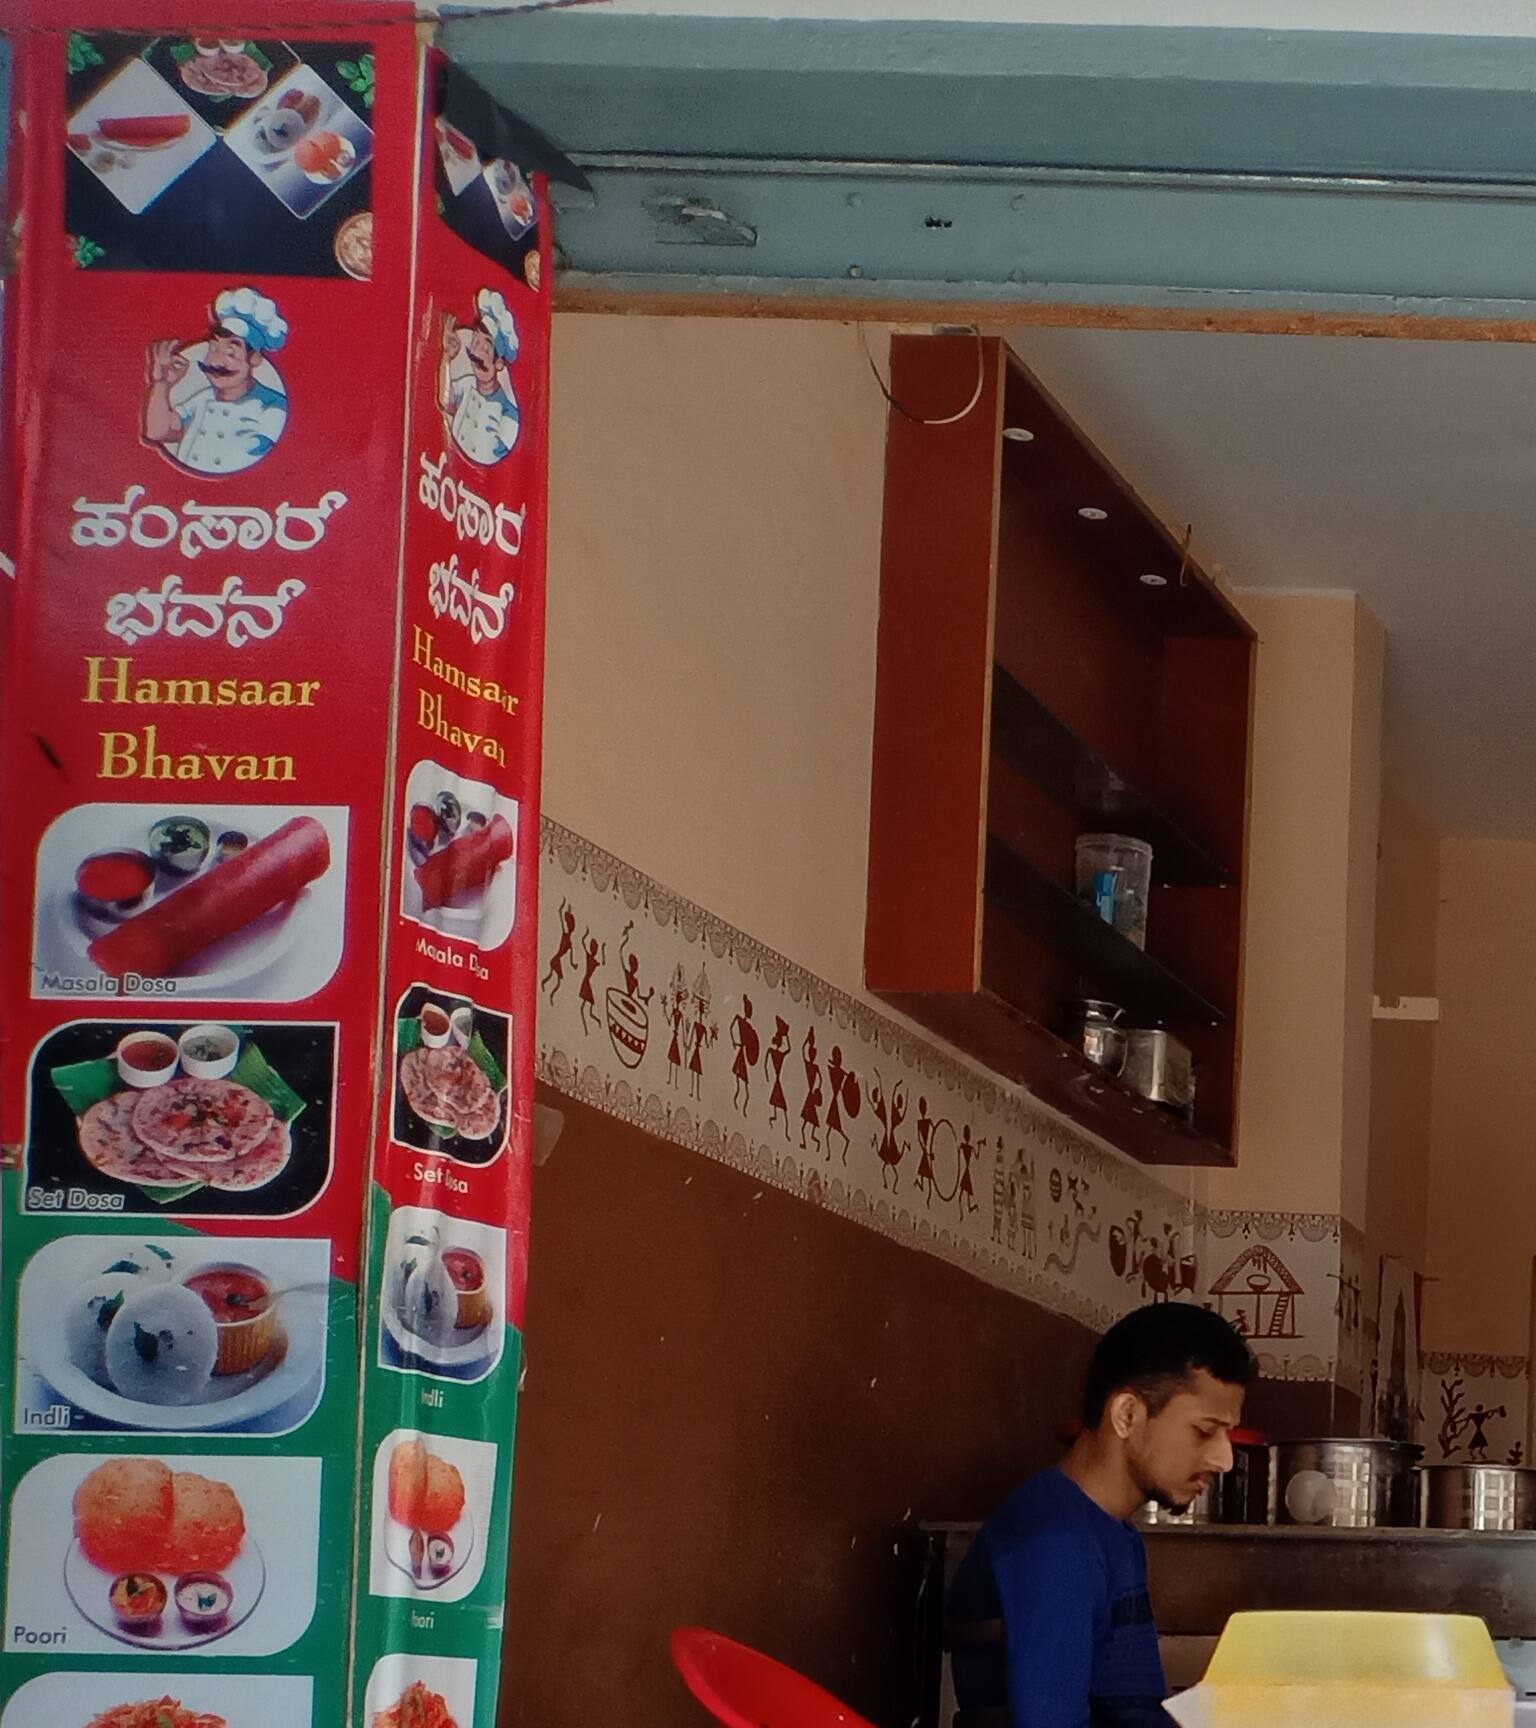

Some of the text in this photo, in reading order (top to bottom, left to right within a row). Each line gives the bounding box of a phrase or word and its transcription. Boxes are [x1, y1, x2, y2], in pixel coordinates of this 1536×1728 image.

[81, 655, 321, 707] Hamsaar
[412, 623, 520, 717] Hamsar
[96, 723, 297, 781] Bhavan
[415, 936, 464, 968] Maala
[41, 971, 178, 993] Masala Dosa
[413, 1161, 443, 1185] Set
[29, 1186, 125, 1210] Set Dosa
[23, 1405, 71, 1427] Indli
[14, 1625, 68, 1645] Poori
